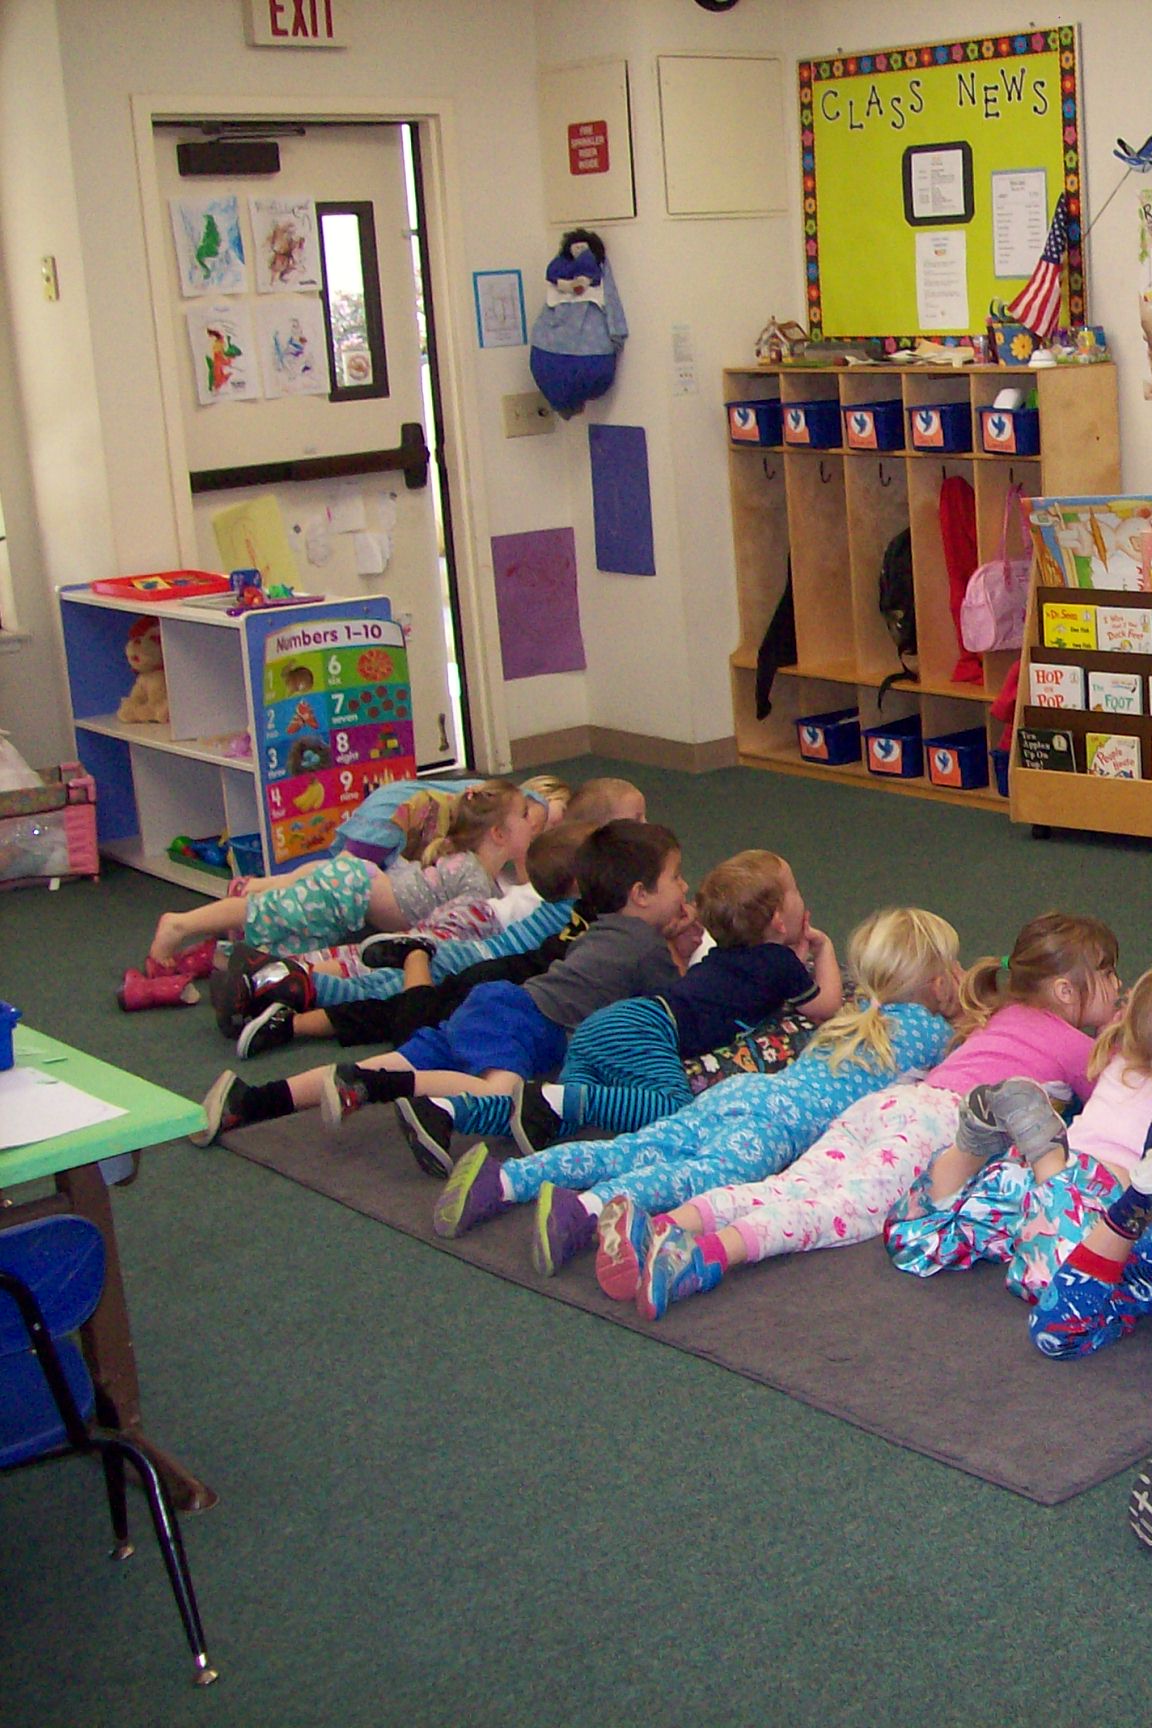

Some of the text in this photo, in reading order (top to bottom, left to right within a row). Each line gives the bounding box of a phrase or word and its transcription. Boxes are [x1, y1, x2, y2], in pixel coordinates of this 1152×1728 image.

[269, 0, 333, 38] EXIT
[821, 67, 1049, 130] CLASS NEWS
[276, 630, 338, 653] Numbers
[328, 655, 342, 675] 6
[1035, 669, 1064, 685] HOP
[331, 693, 345, 714] 7
[1037, 693, 1064, 708] POP
[1104, 694, 1134, 711] FOOT
[267, 709, 276, 730] 2
[336, 732, 350, 752] 8
[1021, 731, 1037, 740] Ten
[1023, 740, 1051, 750] Apples
[267, 748, 278, 769] 3
[340, 771, 353, 792] 9
[270, 786, 281, 807] 4
[275, 826, 286, 848] 5
